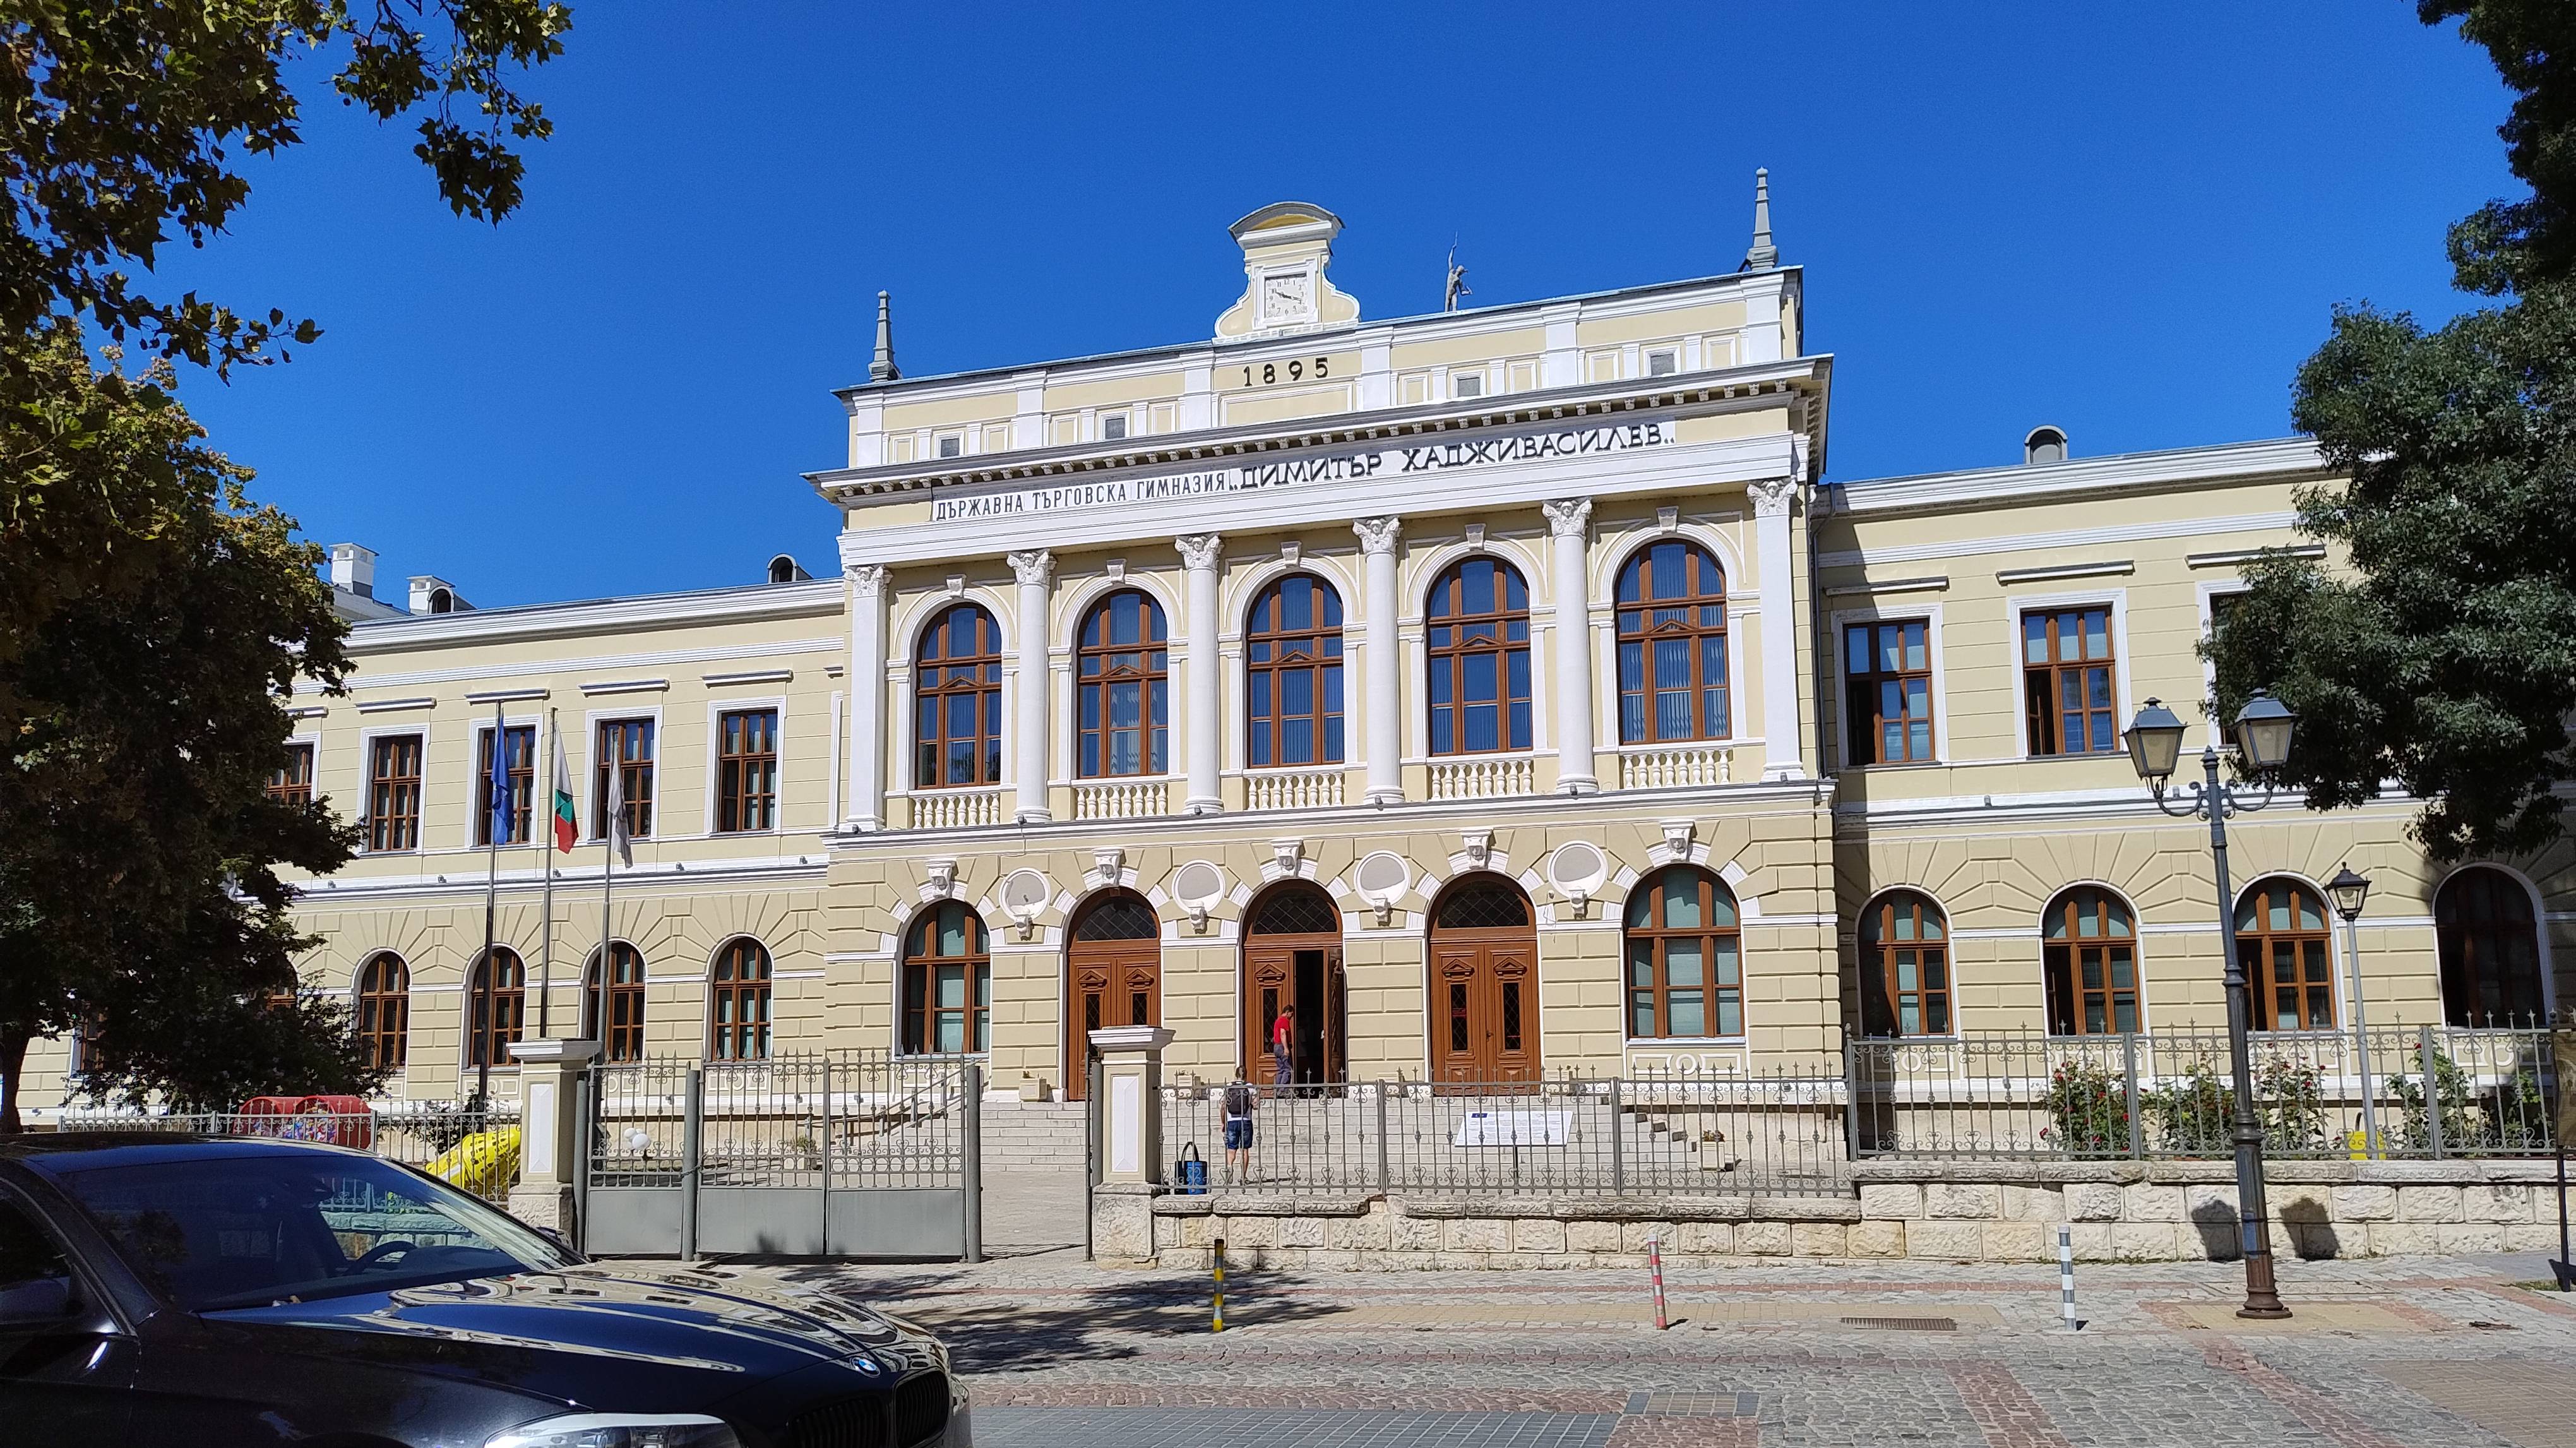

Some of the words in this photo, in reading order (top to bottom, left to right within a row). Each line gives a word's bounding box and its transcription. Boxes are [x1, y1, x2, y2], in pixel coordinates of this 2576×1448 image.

[1243, 357, 1328, 387] 1895
[936, 494, 1023, 521] ДЪРЖАВНА
[1032, 484, 1126, 510] ТЪРГОВСКА
[1136, 472, 1225, 500] ГИМНАЗИЯ
